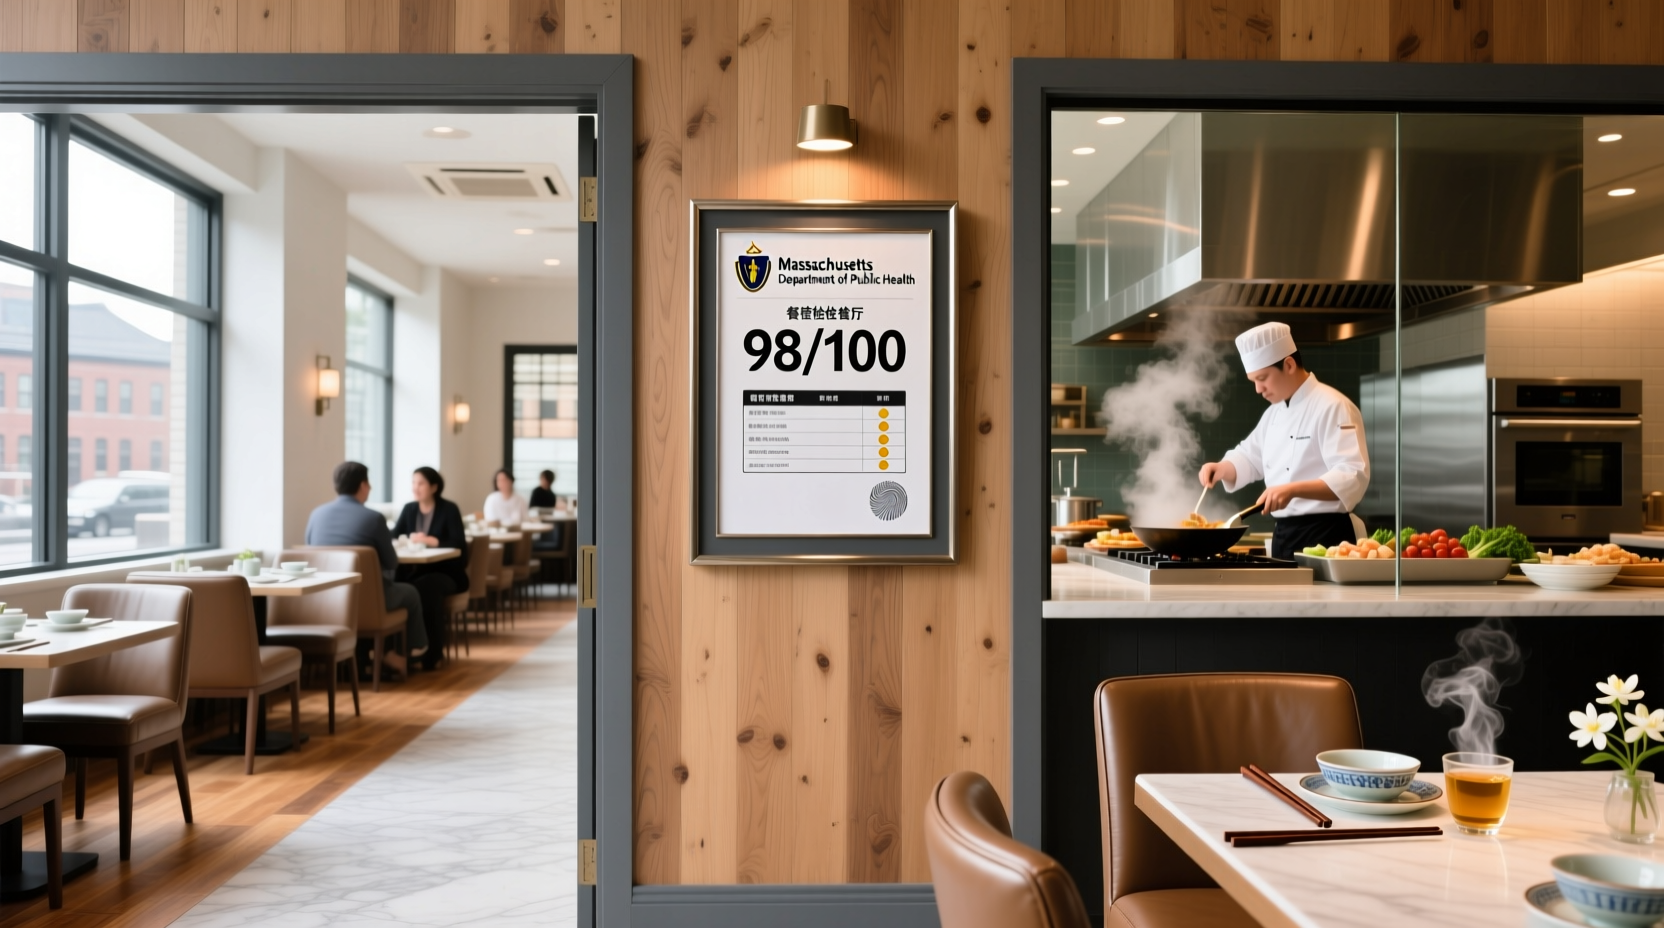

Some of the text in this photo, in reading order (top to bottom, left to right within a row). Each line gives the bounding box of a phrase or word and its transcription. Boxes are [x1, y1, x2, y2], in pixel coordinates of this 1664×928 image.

[778, 257, 873, 271] Massachusetts
[837, 273, 848, 285] of
[850, 272, 881, 285] Public
[882, 273, 916, 285] Health
[743, 327, 906, 376] 98/100
